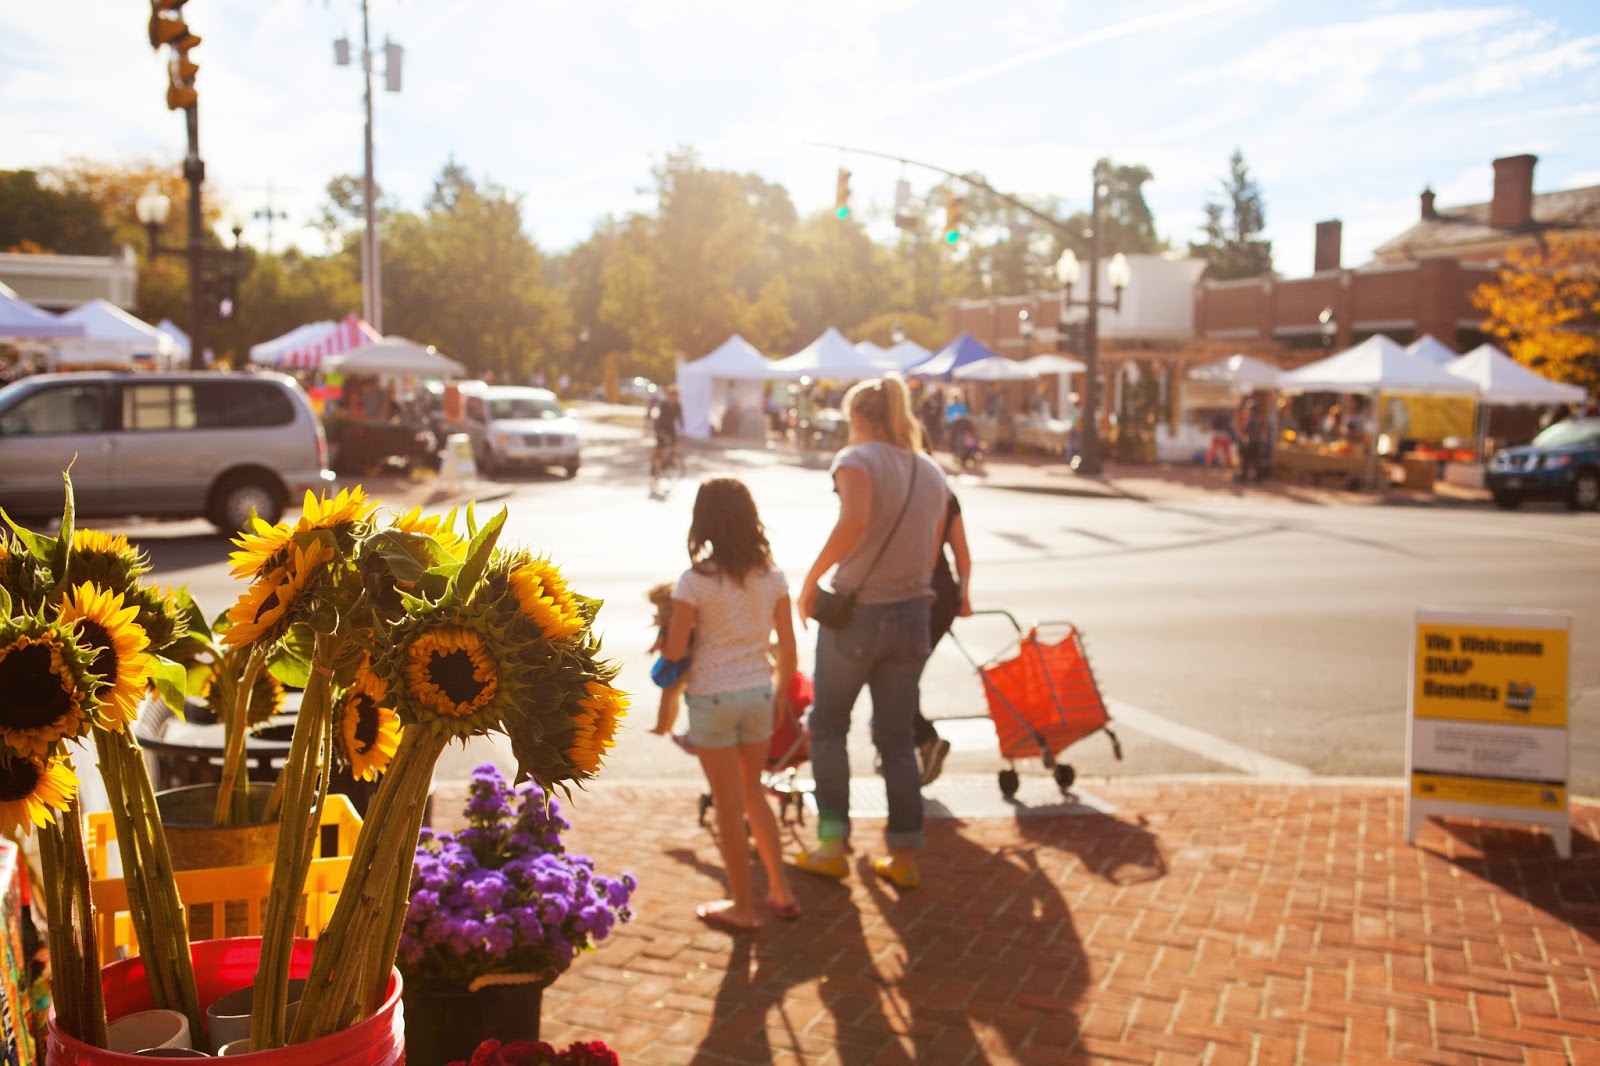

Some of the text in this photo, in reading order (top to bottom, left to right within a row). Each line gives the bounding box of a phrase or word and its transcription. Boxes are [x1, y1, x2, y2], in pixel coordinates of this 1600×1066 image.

[1425, 634, 1544, 657] We Welcome
[1425, 656, 1473, 675] SNAP
[1423, 680, 1498, 701] Benefits
